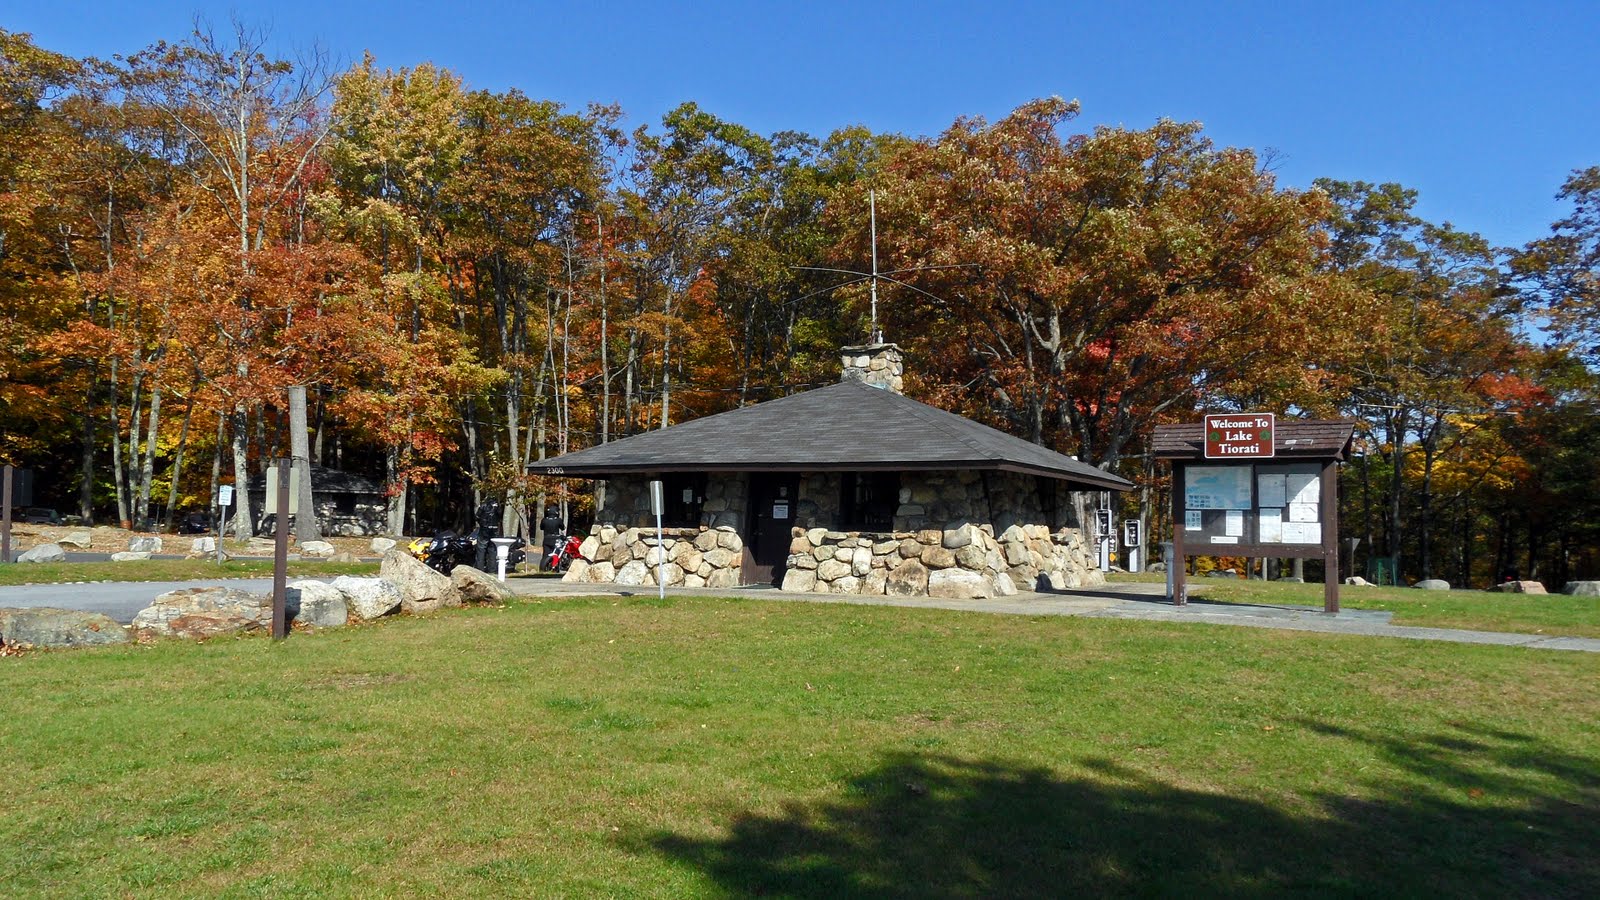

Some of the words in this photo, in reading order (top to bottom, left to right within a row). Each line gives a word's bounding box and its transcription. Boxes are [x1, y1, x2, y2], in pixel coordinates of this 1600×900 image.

[1210, 419, 1253, 429] Welcome
[1255, 418, 1269, 428] To
[1225, 430, 1252, 441] Lake
[1218, 443, 1260, 454] Tiorati
